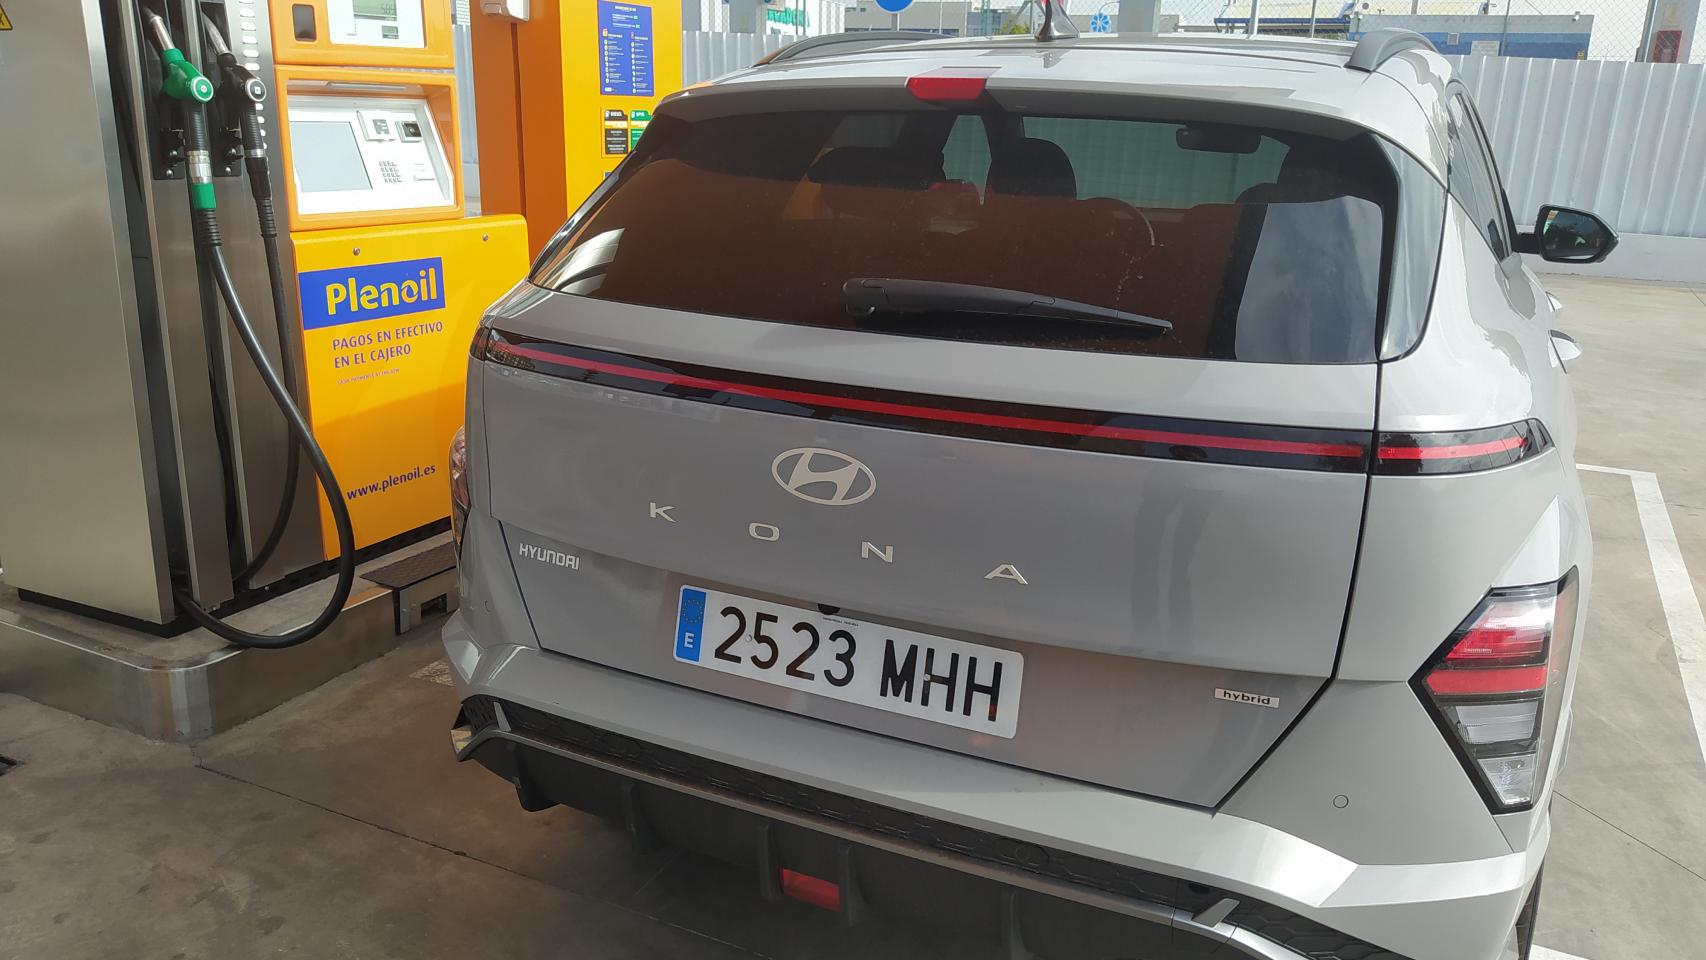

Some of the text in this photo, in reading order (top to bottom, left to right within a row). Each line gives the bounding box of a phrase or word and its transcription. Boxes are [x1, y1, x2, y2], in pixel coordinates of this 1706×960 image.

[326, 267, 437, 315] Plenoil
[332, 321, 443, 351] PAGOS EN EFECTIVO
[334, 343, 411, 369] EN EL CAJERO
[346, 464, 436, 500] www.plenoil.es
[519, 542, 580, 570] HYUNDAI
[683, 632, 695, 649] E
[714, 606, 1003, 722] 2523 MHH
[1223, 690, 1271, 705] hybrid
